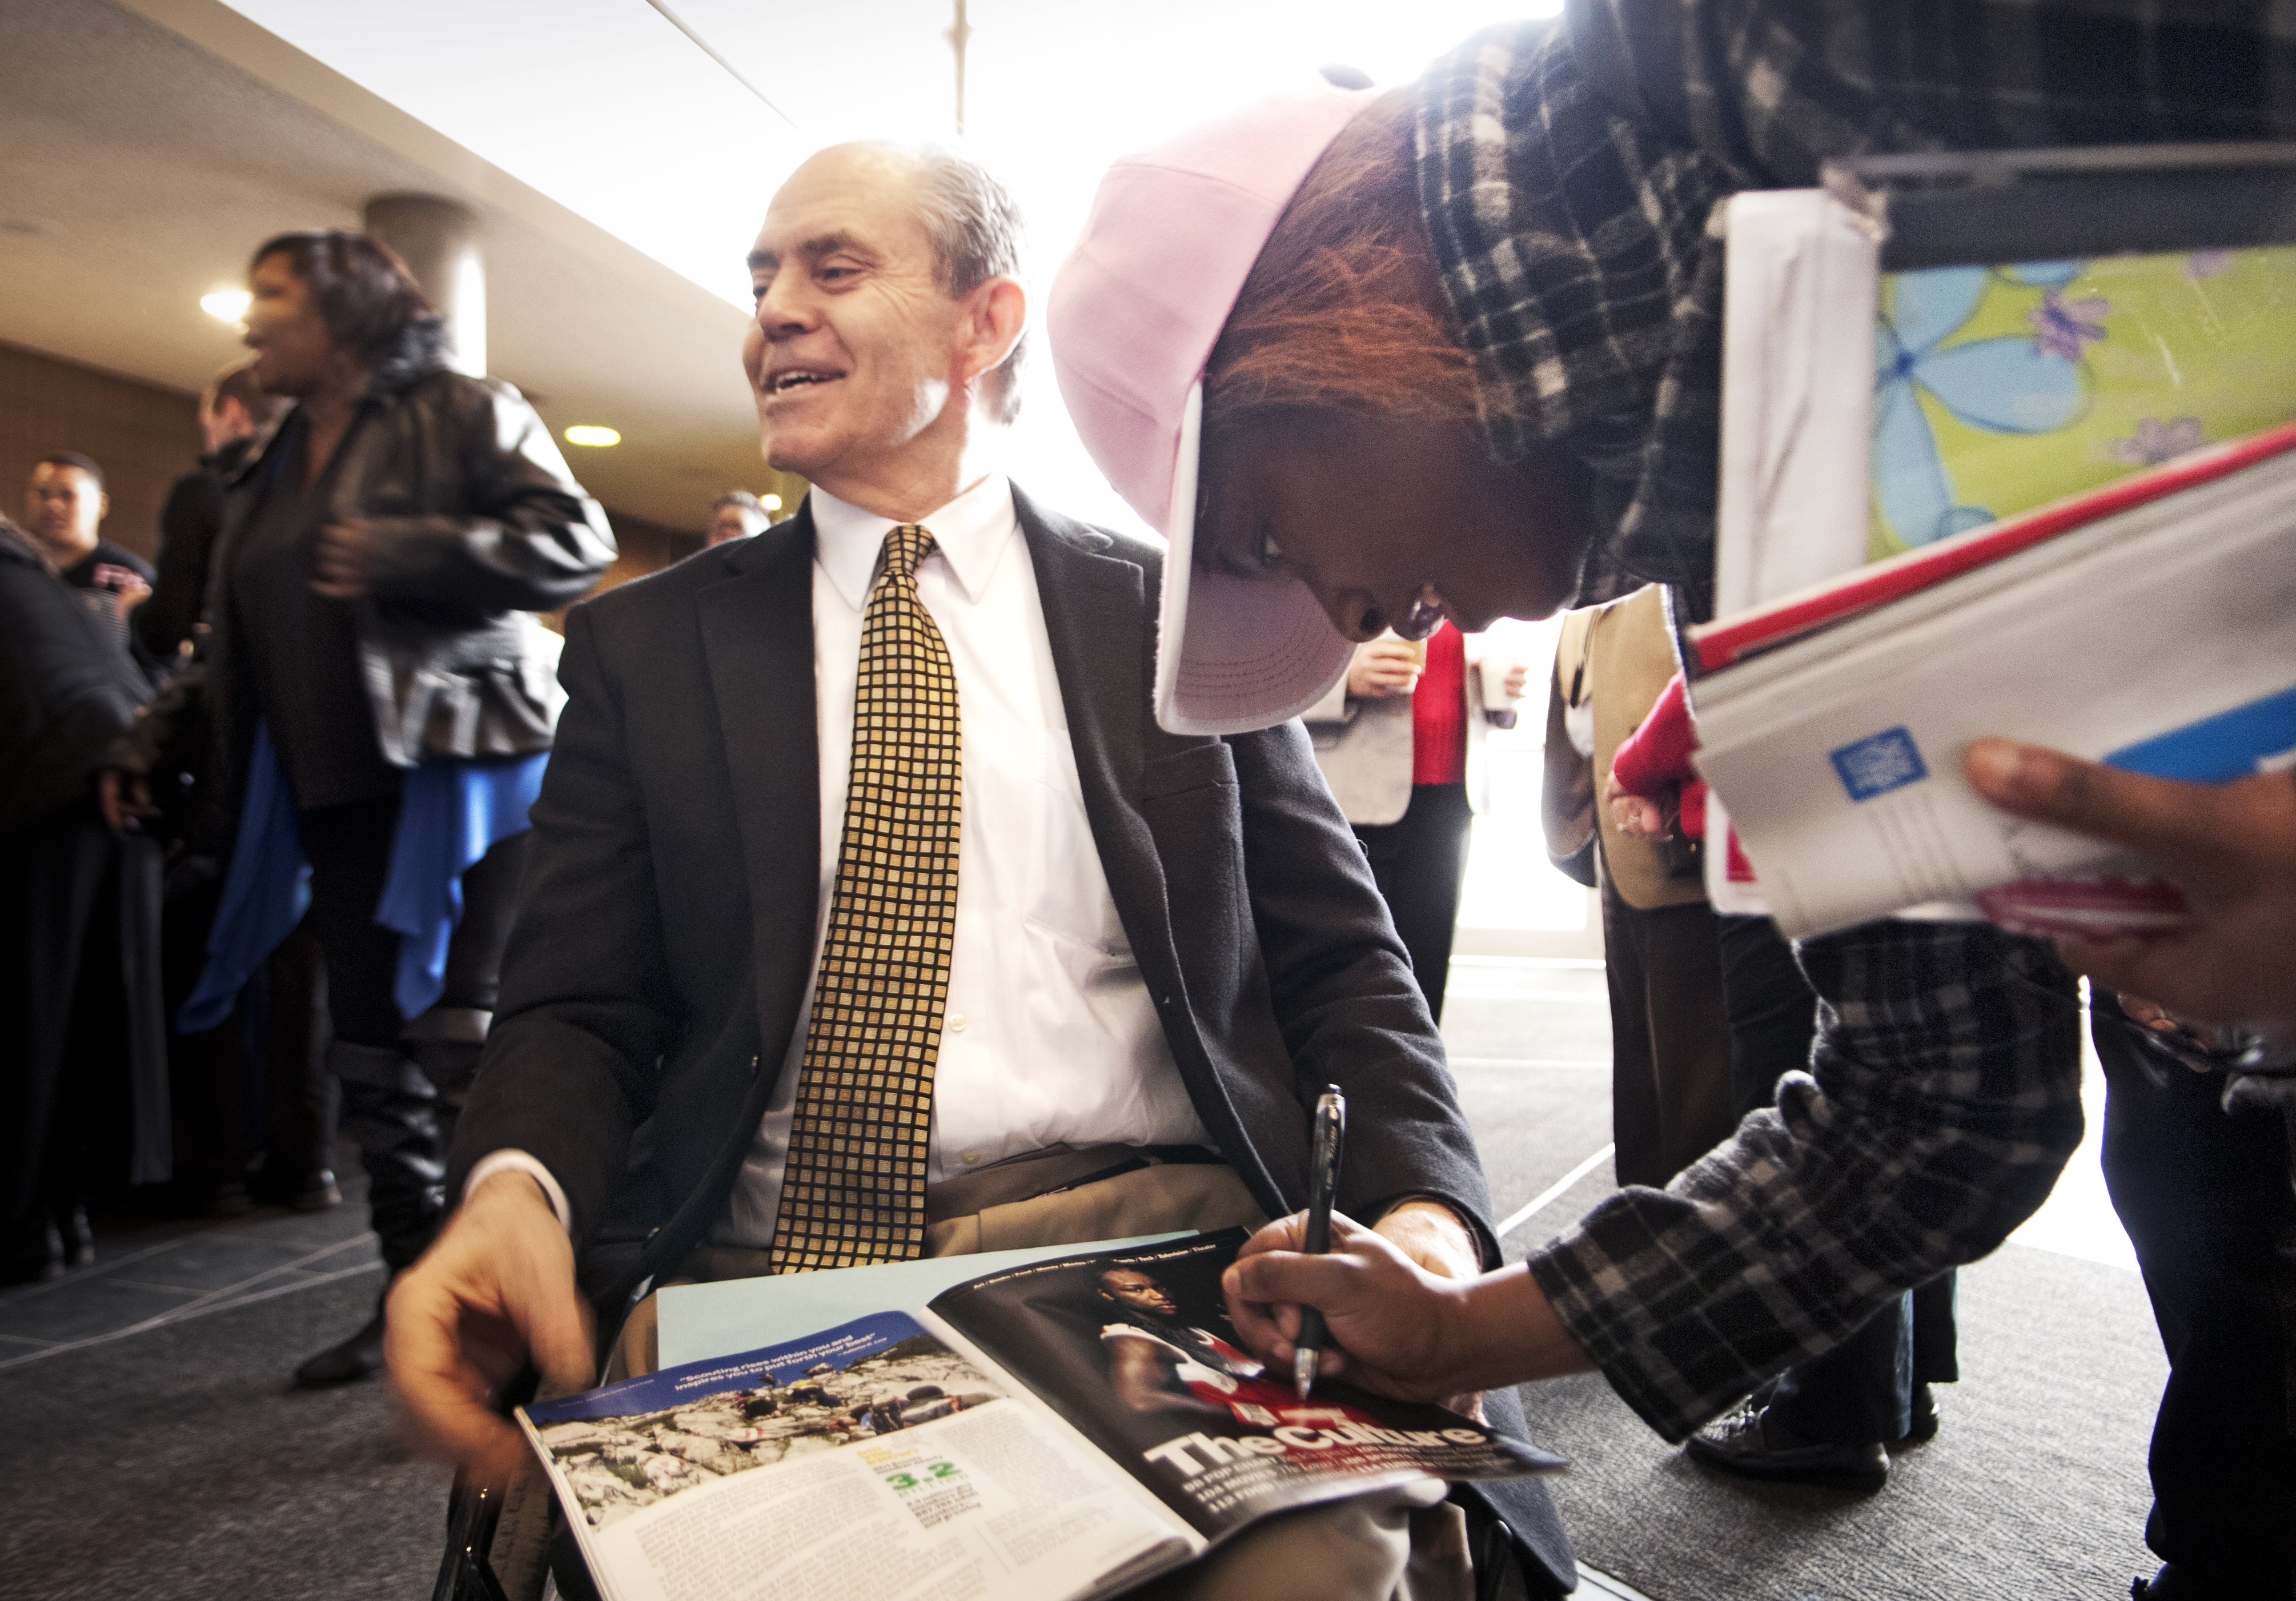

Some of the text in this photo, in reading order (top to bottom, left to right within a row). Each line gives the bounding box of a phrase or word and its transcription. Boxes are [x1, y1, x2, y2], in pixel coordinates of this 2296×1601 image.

[1157, 1249, 1189, 1259] Television
[725, 1370, 748, 1379] you
[764, 1361, 786, 1371] put
[786, 1353, 817, 1364] forth
[818, 1345, 844, 1357] your
[741, 1360, 770, 1370] rises
[771, 1351, 807, 1363] within
[808, 1343, 830, 1354] you
[831, 1334, 853, 1346] and
[885, 1462, 962, 1490] 3.2
